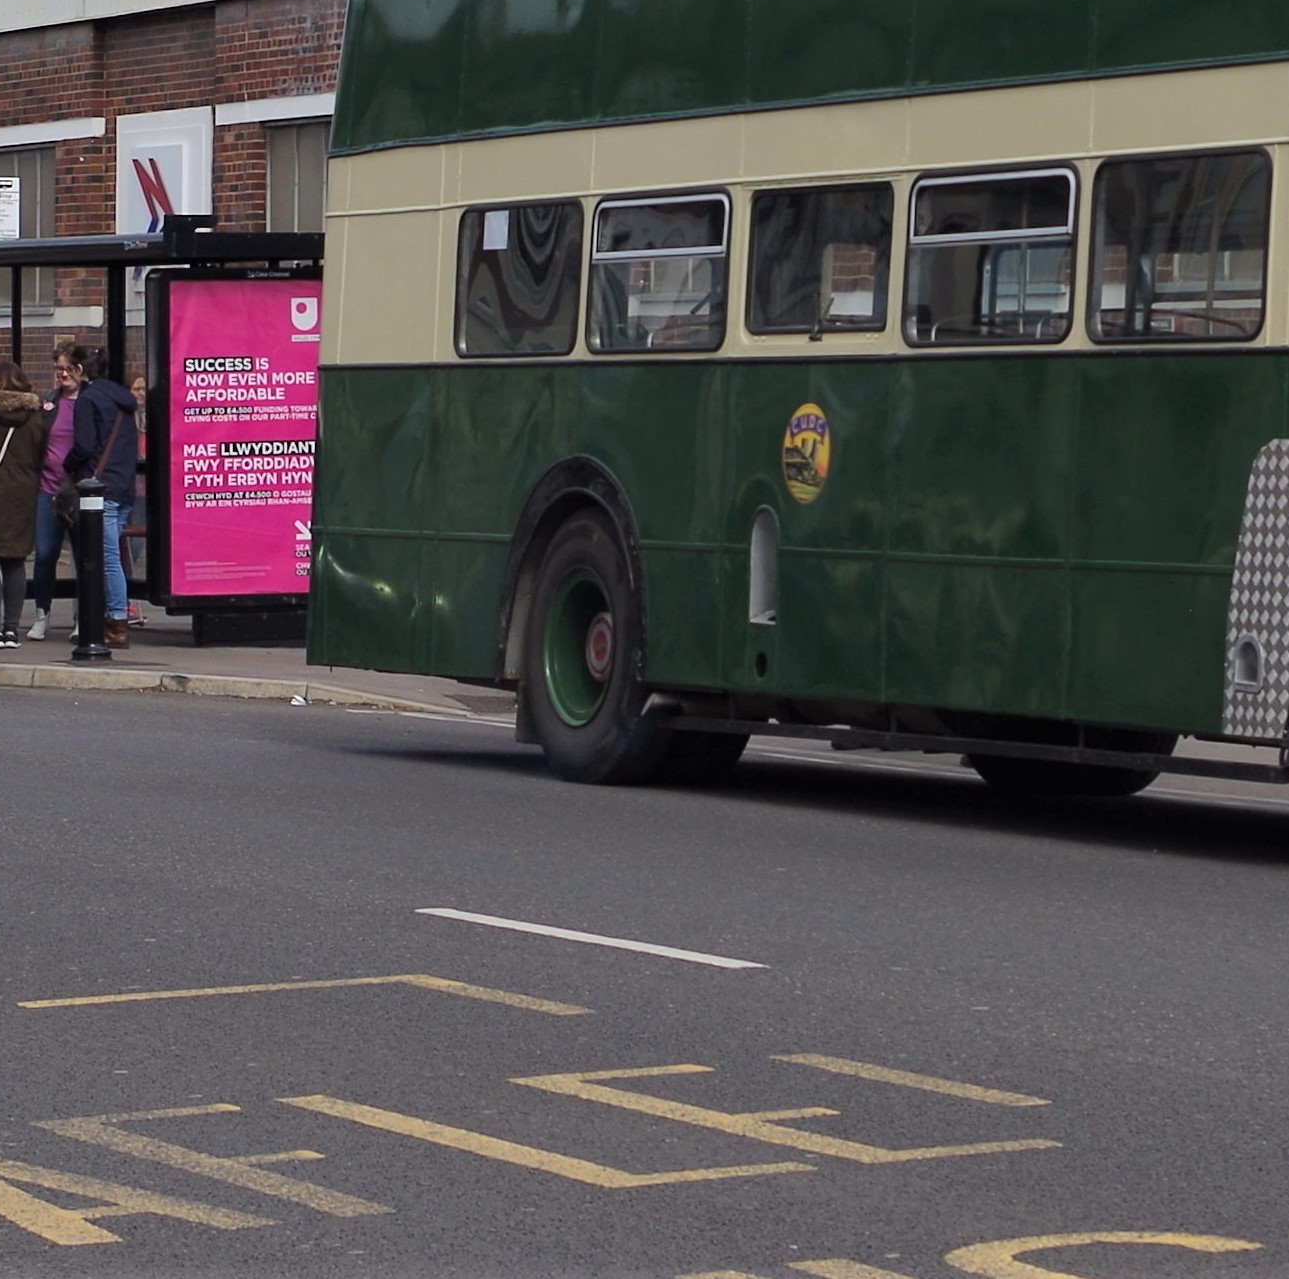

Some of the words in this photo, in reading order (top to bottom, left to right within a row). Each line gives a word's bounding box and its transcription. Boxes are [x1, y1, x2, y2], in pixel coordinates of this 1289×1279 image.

[185, 358, 252, 371] SUCCESS
[256, 358, 269, 370] IS
[186, 373, 223, 387] NOW
[228, 373, 268, 386] EVEN
[272, 371, 315, 385] MORE
[186, 387, 285, 402] AFFORDABLE
[201, 407, 212, 415] UP
[254, 405, 289, 413] FUNDING
[184, 414, 211, 423] LIVING
[212, 414, 237, 422] COSTS
[239, 413, 250, 421] ON
[252, 413, 268, 421] OUR
[270, 412, 308, 420] PART-TIME
[792, 414, 825, 433] CUDC
[183, 444, 217, 457] MAE
[184, 459, 220, 472] FWY
[184, 474, 223, 487] FYTH
[228, 473, 277, 486] ERBYN
[282, 471, 312, 484] HYN
[185, 492, 213, 500] CEWCH
[216, 492, 232, 500] HYD
[234, 491, 243, 499] AT
[185, 500, 203, 508] BYW
[205, 500, 217, 508] AR
[219, 499, 232, 507] EIN
[234, 498, 266, 507] CYRSIAU
